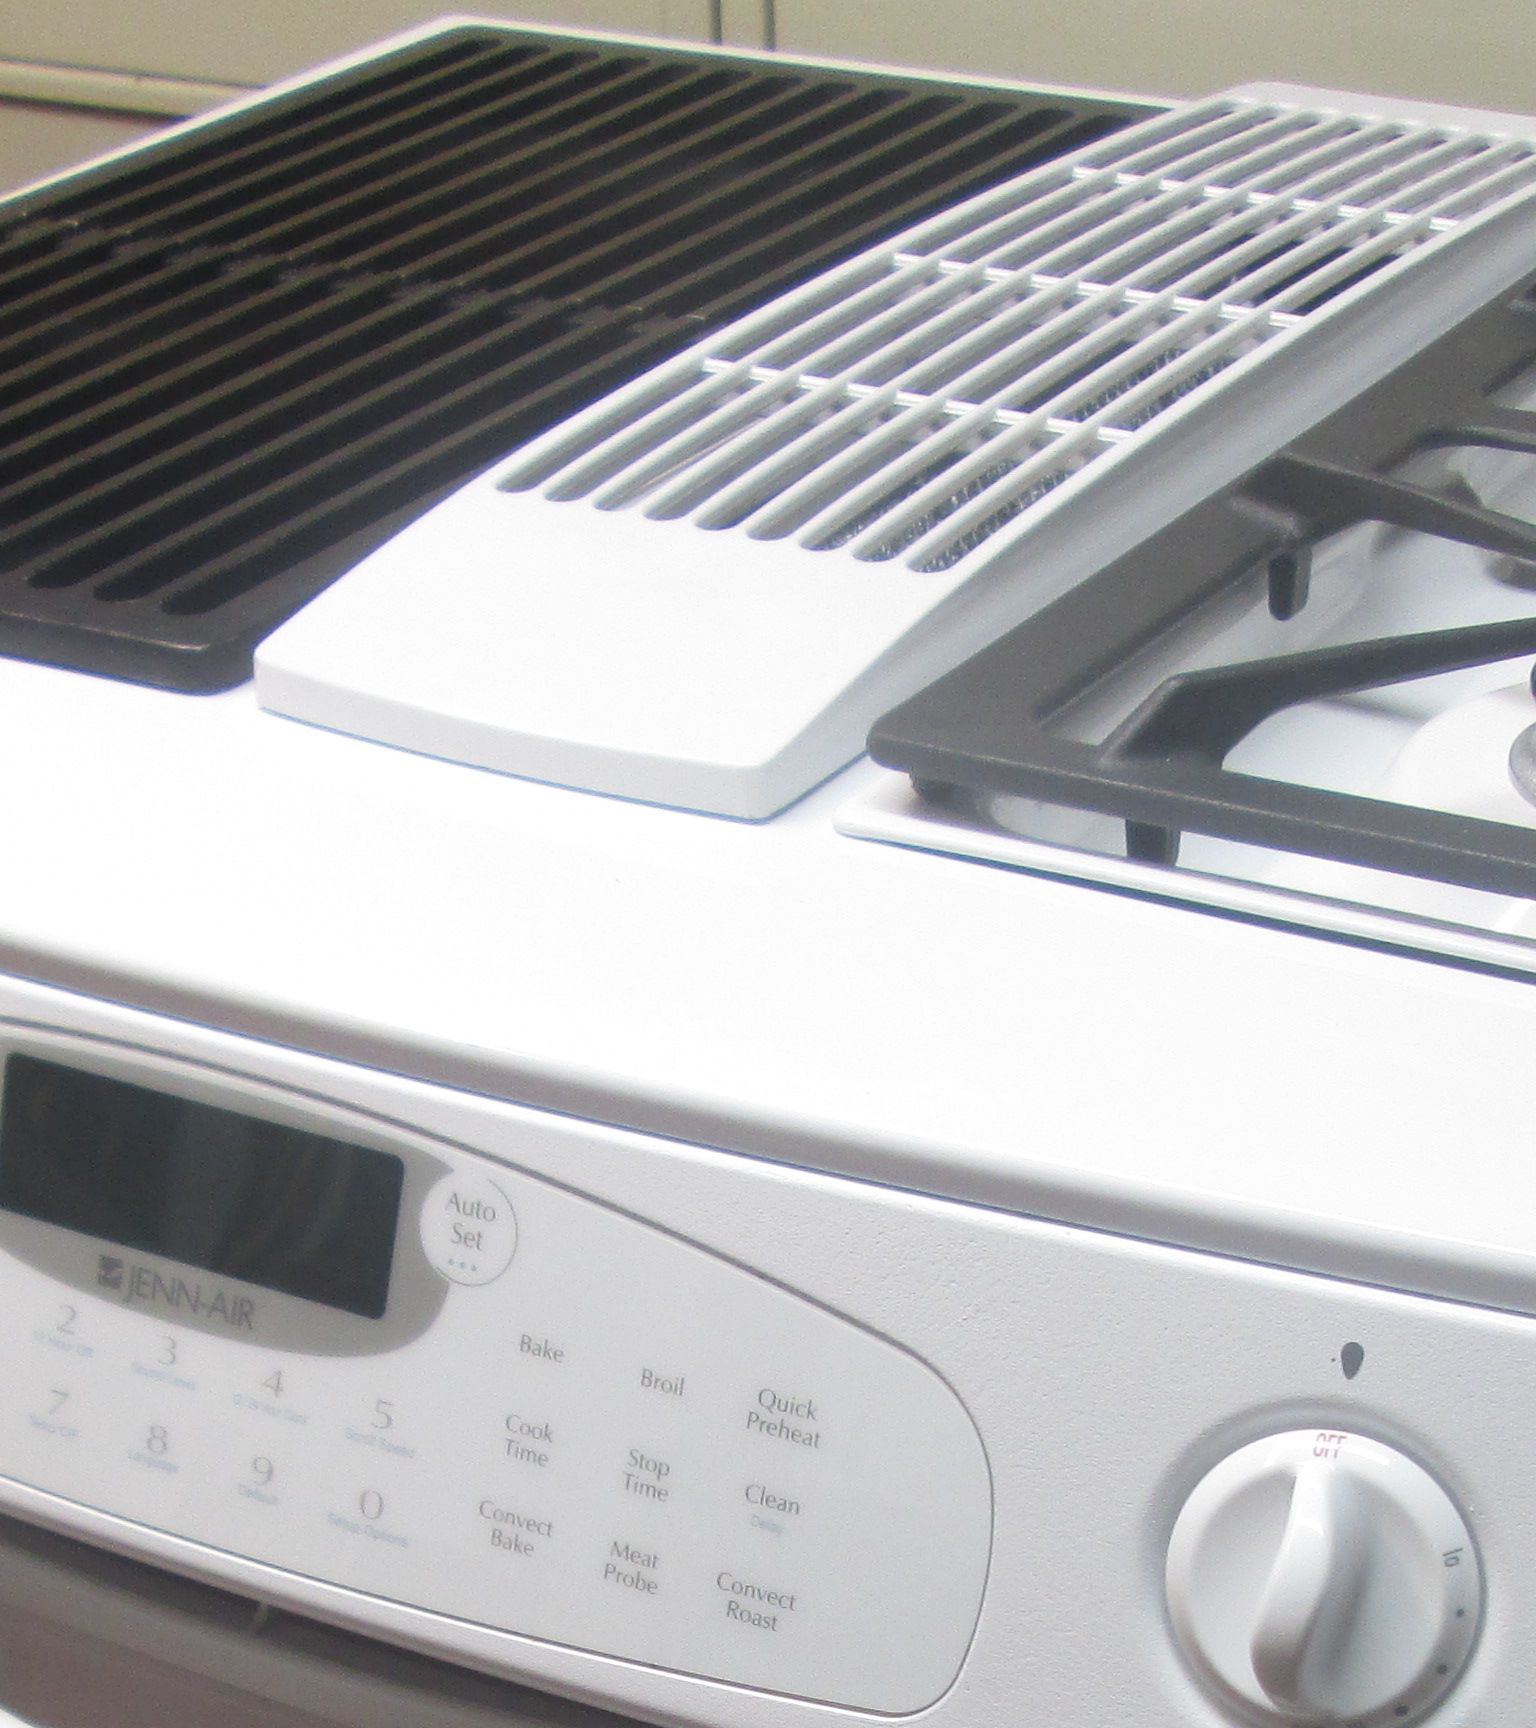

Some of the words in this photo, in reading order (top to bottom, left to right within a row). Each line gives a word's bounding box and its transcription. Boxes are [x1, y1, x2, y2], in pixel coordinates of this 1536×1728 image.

[446, 1191, 497, 1222] Auto
[449, 1221, 482, 1252] Set
[124, 1264, 257, 1330] JENN-AIR
[56, 1304, 76, 1335] 2
[158, 1335, 177, 1365] 3
[519, 1334, 565, 1363] Bake
[263, 1370, 285, 1397] 4
[640, 1368, 685, 1397] Broil
[50, 1388, 70, 1416] 7
[371, 1399, 394, 1430] 5
[758, 1388, 818, 1422] Quick
[147, 1425, 168, 1454] 8
[505, 1413, 554, 1444] Cook
[746, 1411, 822, 1449] Preheat
[504, 1438, 550, 1468] Time
[1313, 1432, 1348, 1458] OFF
[252, 1456, 274, 1487] 9
[627, 1448, 672, 1479] Stop
[622, 1473, 670, 1503] Time
[745, 1484, 801, 1515] Clean
[478, 1500, 554, 1539] Convect
[489, 1528, 536, 1558] Bake
[609, 1540, 660, 1571] Meat
[603, 1562, 659, 1596] Probe
[716, 1571, 796, 1611] Convect
[725, 1600, 779, 1633] Roast
